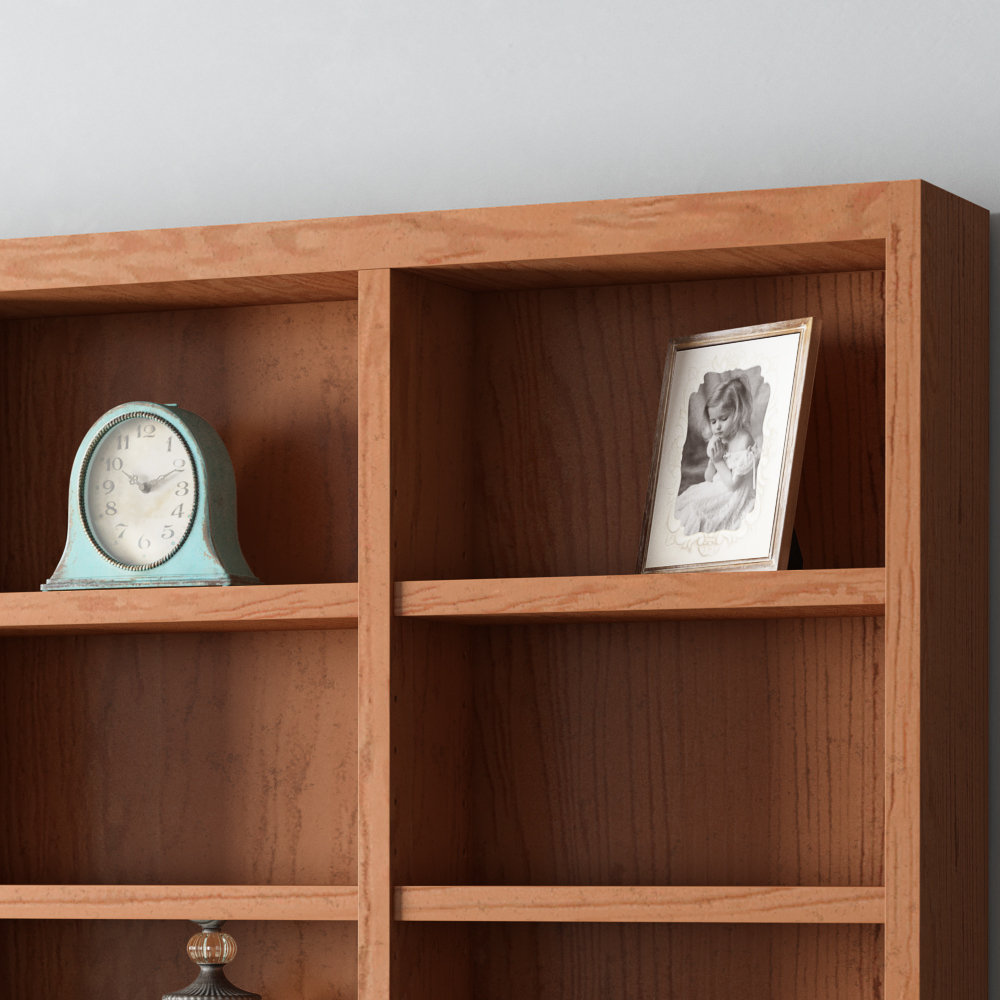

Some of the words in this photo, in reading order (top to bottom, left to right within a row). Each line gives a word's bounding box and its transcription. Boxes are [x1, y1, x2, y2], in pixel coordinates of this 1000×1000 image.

[137, 424, 156, 438] 12
[117, 435, 130, 450] 11
[166, 436, 173, 452] 1
[106, 457, 123, 472] 10
[173, 458, 186, 472] 2
[102, 479, 115, 495] 9
[175, 481, 189, 496] 3
[105, 501, 117, 516] 8
[171, 503, 185, 518] 4
[115, 523, 128, 539] 7
[161, 524, 174, 539] 5
[138, 535, 150, 550] 6
